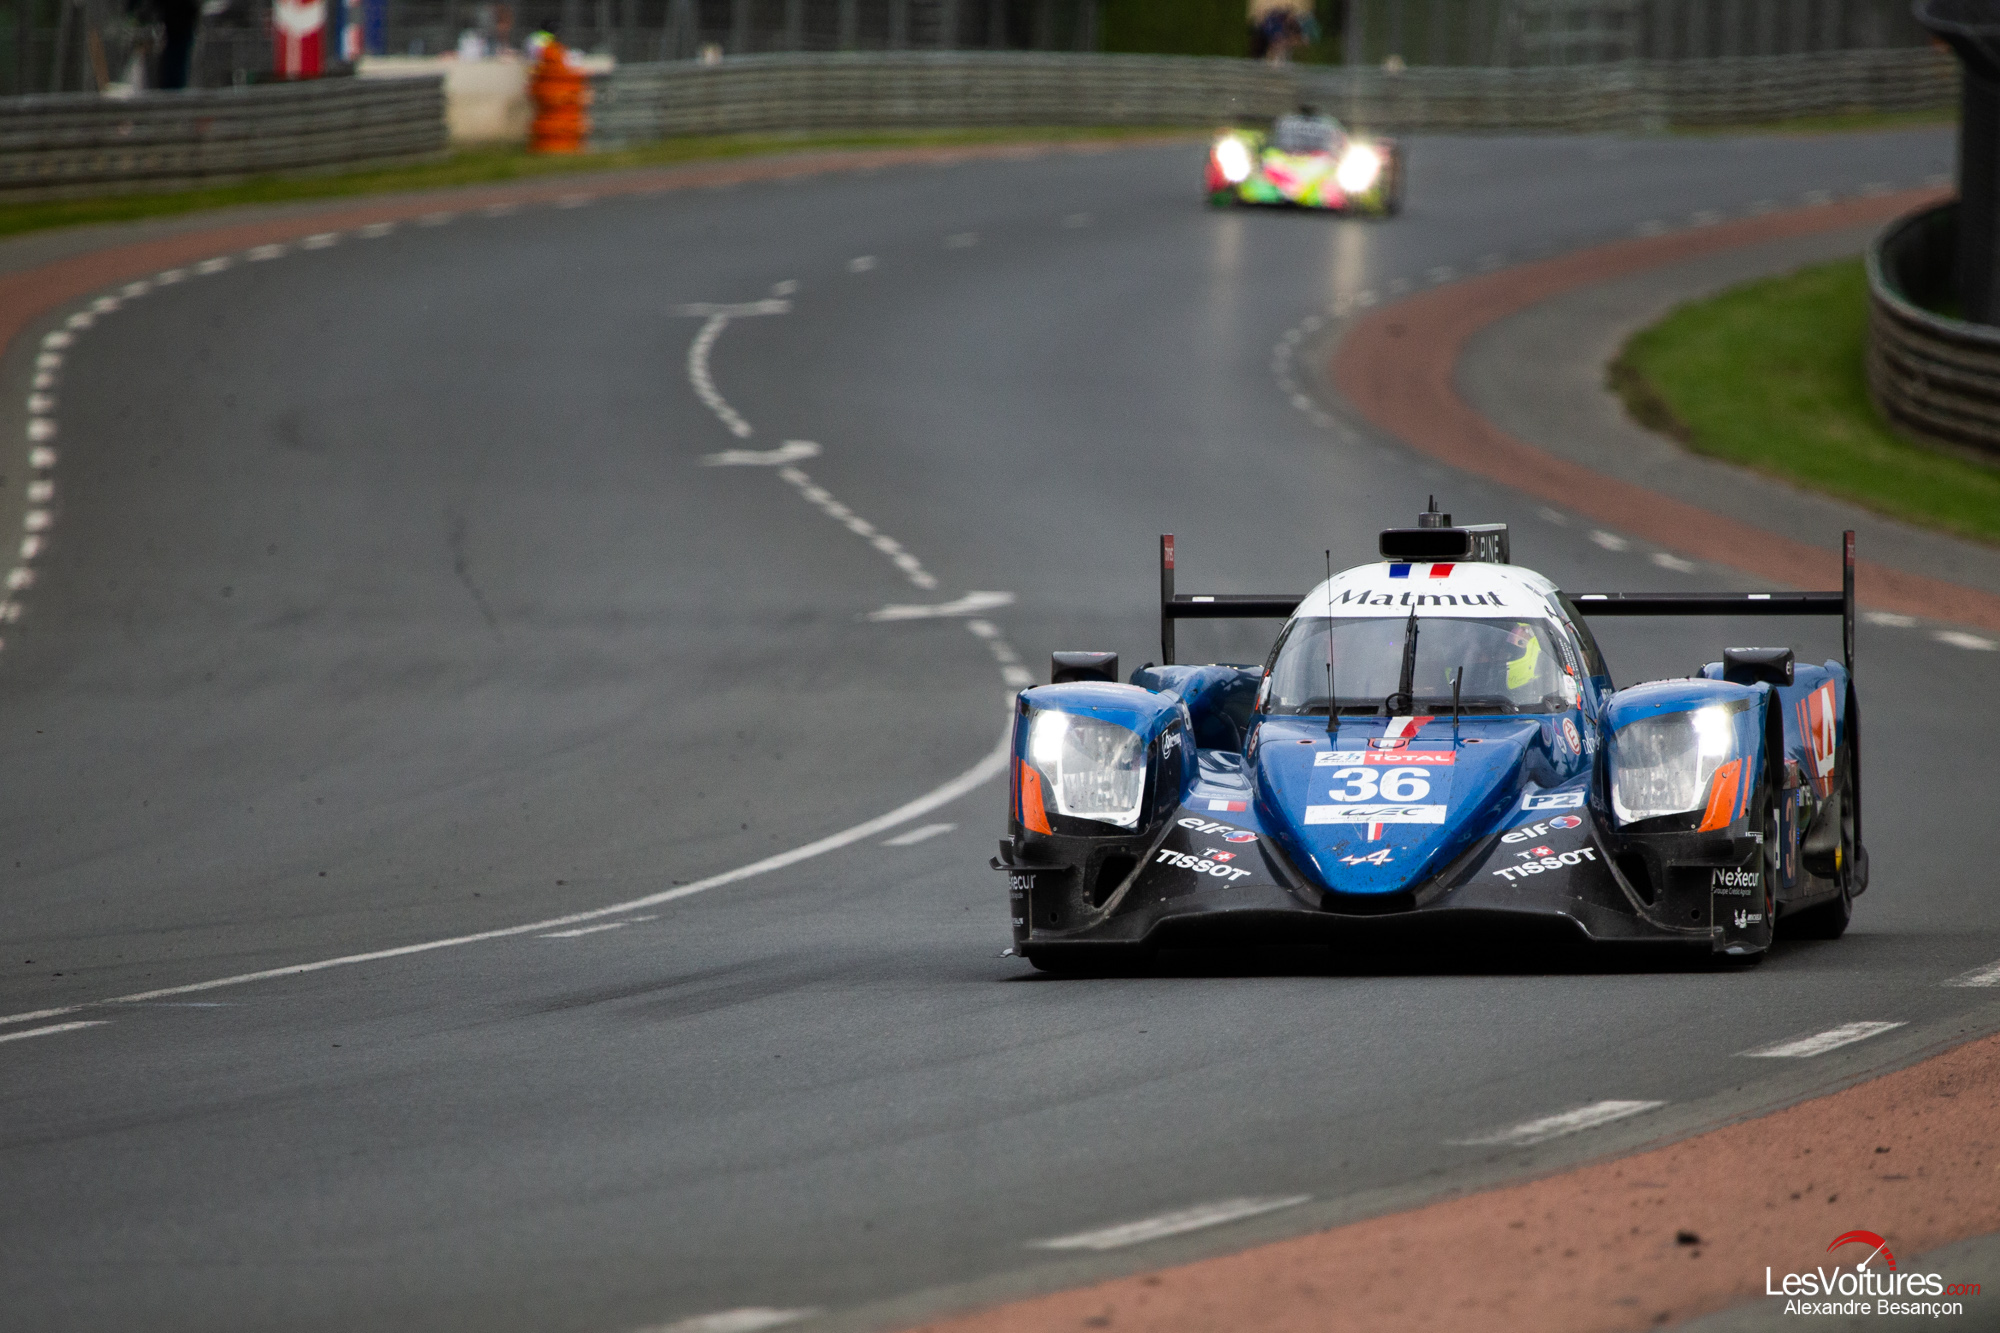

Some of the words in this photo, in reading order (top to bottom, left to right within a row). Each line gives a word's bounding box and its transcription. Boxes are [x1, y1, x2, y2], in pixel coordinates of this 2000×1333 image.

[1329, 589, 1508, 607] Matmut
[1369, 753, 1451, 763] TOTAL
[1328, 766, 1431, 802] 36
[1528, 794, 1579, 808] P2
[1341, 807, 1426, 816] WEC
[1177, 817, 1235, 834] elf
[1501, 823, 1549, 843] elf
[1156, 849, 1252, 881] TISSOT
[1492, 847, 1597, 881] TISSOT
[1712, 866, 1760, 887] Nexecur
